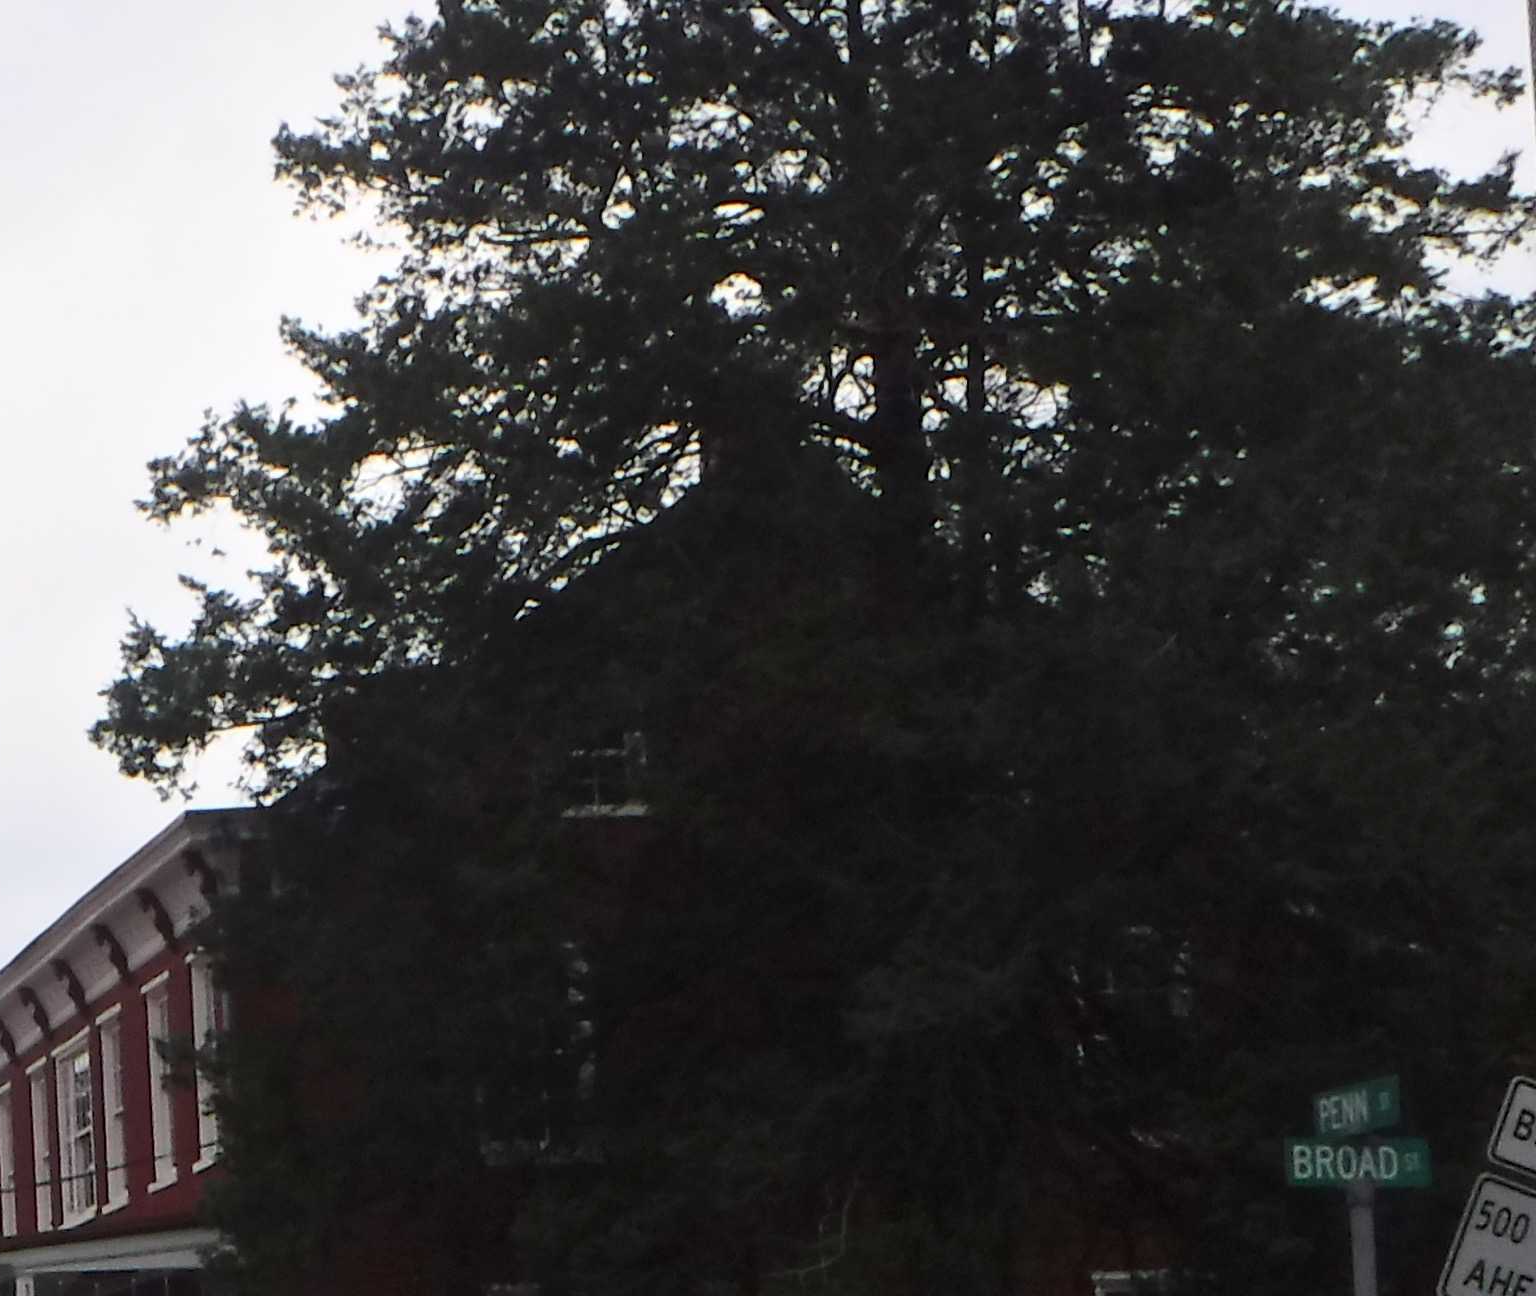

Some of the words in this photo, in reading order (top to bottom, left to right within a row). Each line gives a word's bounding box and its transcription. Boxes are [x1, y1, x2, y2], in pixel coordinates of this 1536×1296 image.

[1318, 1088, 1369, 1133] PENN
[1513, 1108, 1536, 1145] B
[1292, 1145, 1398, 1179] BROAD
[1475, 1199, 1530, 1244] 500
